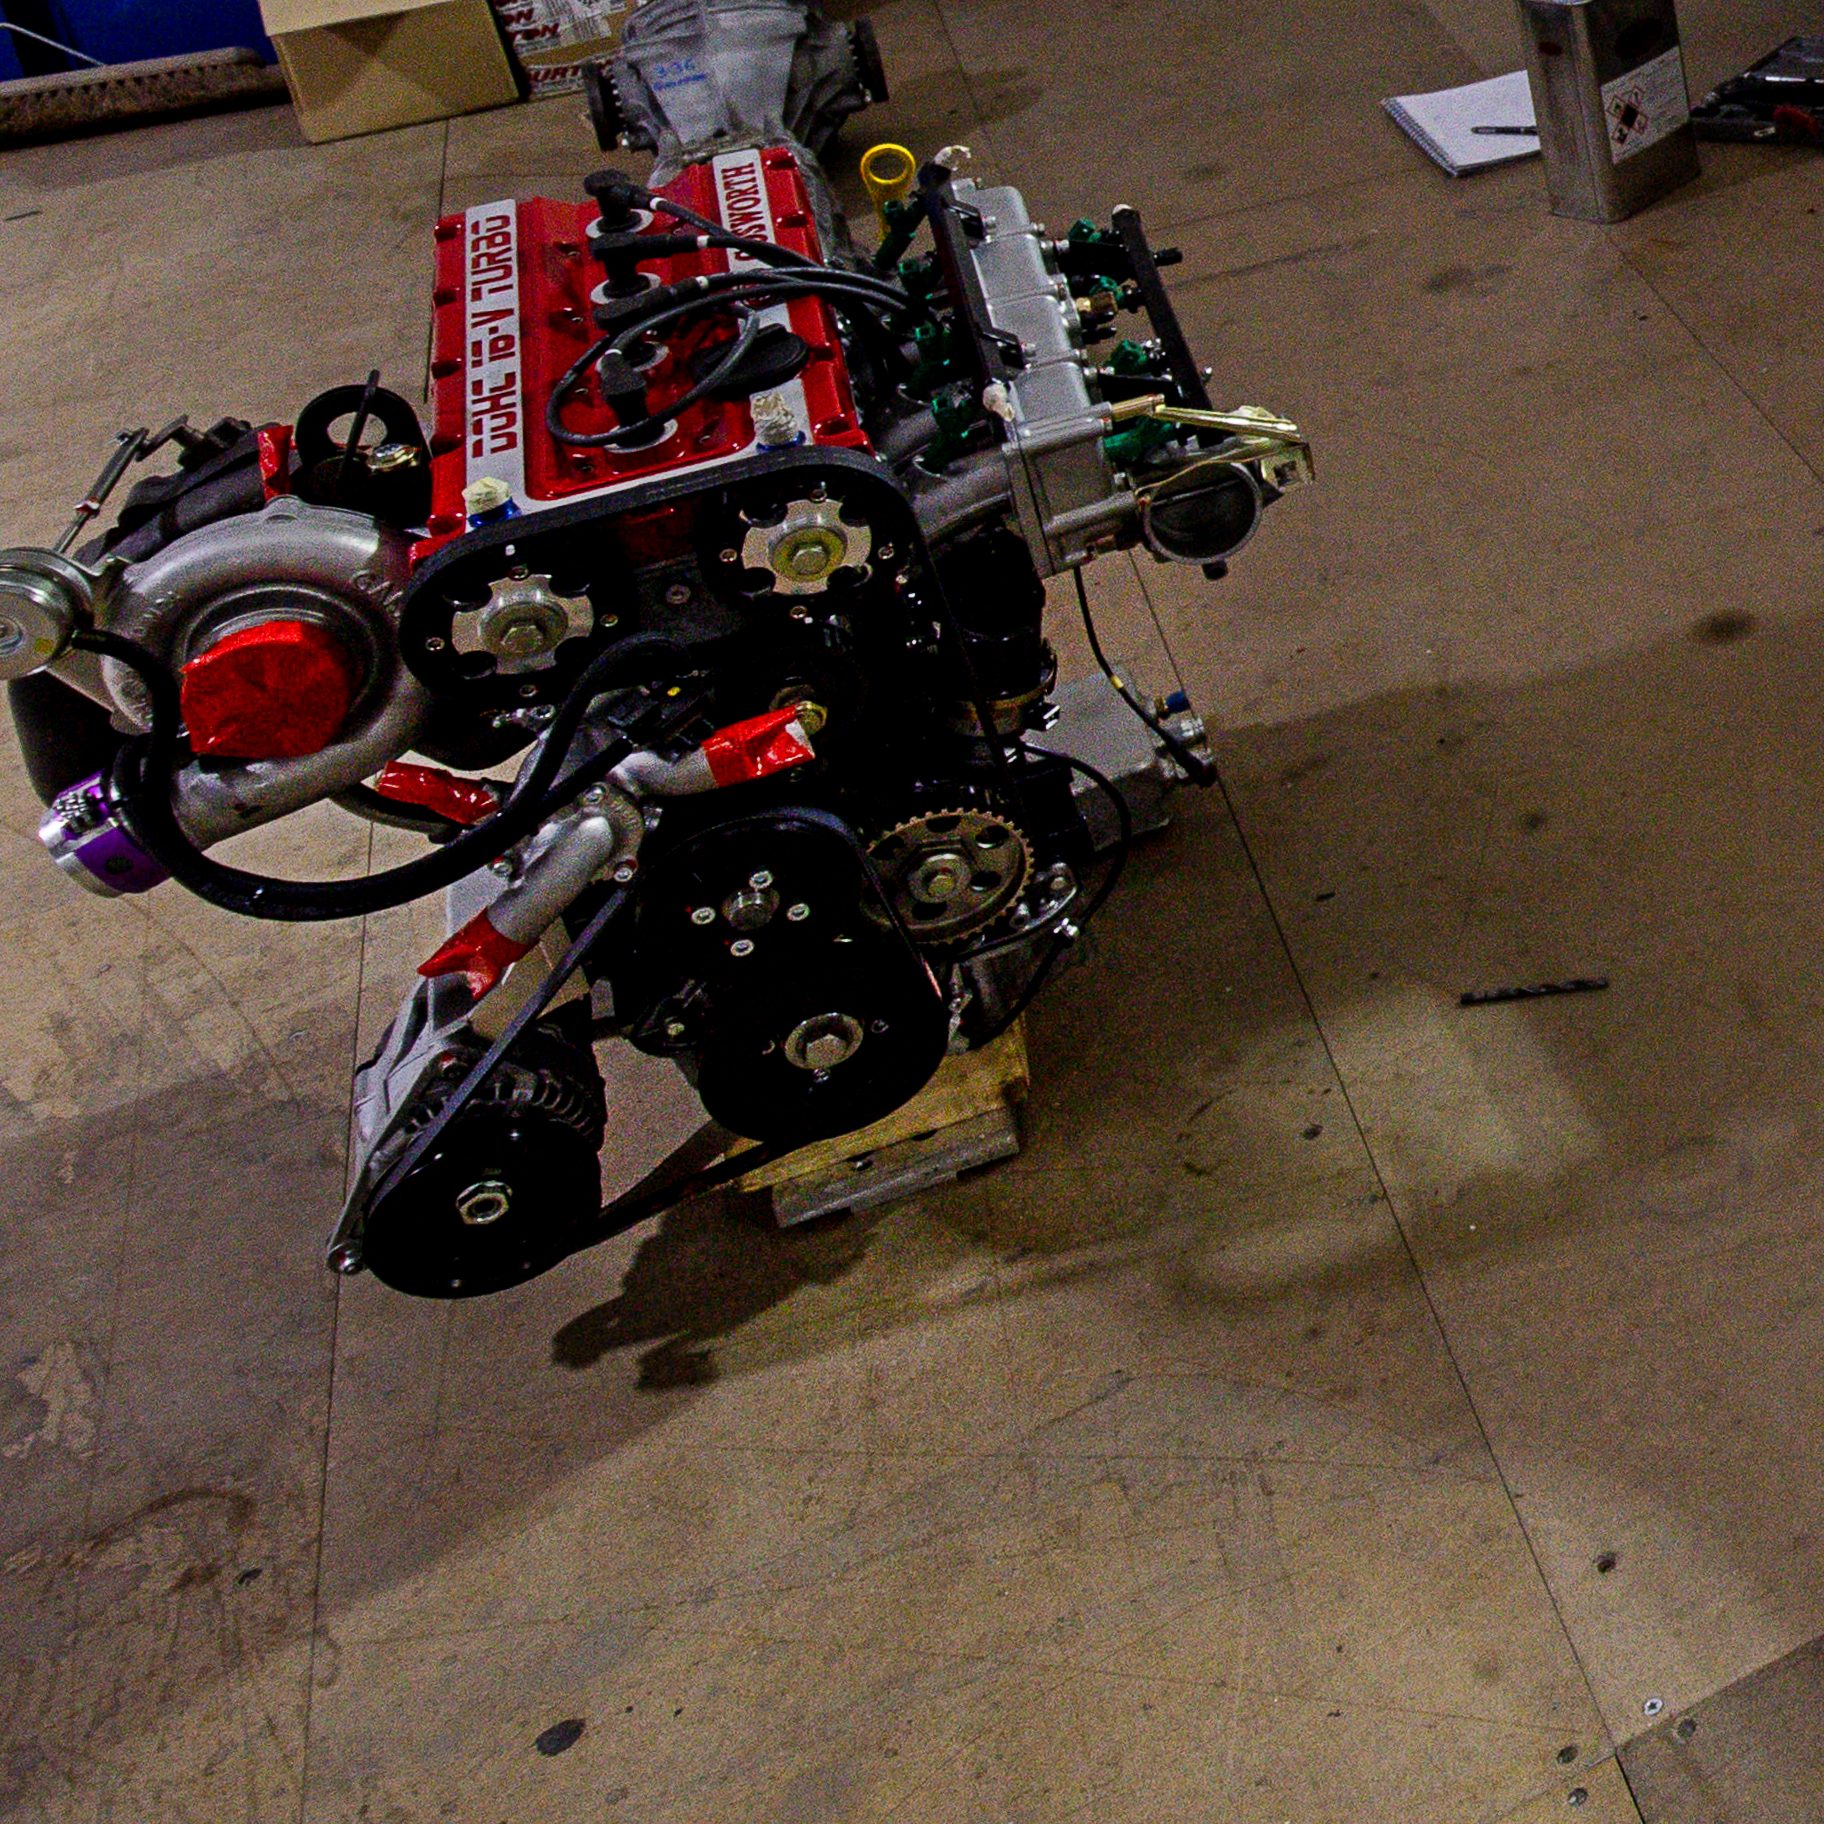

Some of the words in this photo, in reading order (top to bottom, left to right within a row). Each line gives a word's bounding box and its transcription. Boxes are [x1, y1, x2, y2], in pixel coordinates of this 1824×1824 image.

[470, 214, 515, 303] TURBO
[470, 307, 516, 369] 16-V
[471, 371, 518, 459] DOHC
